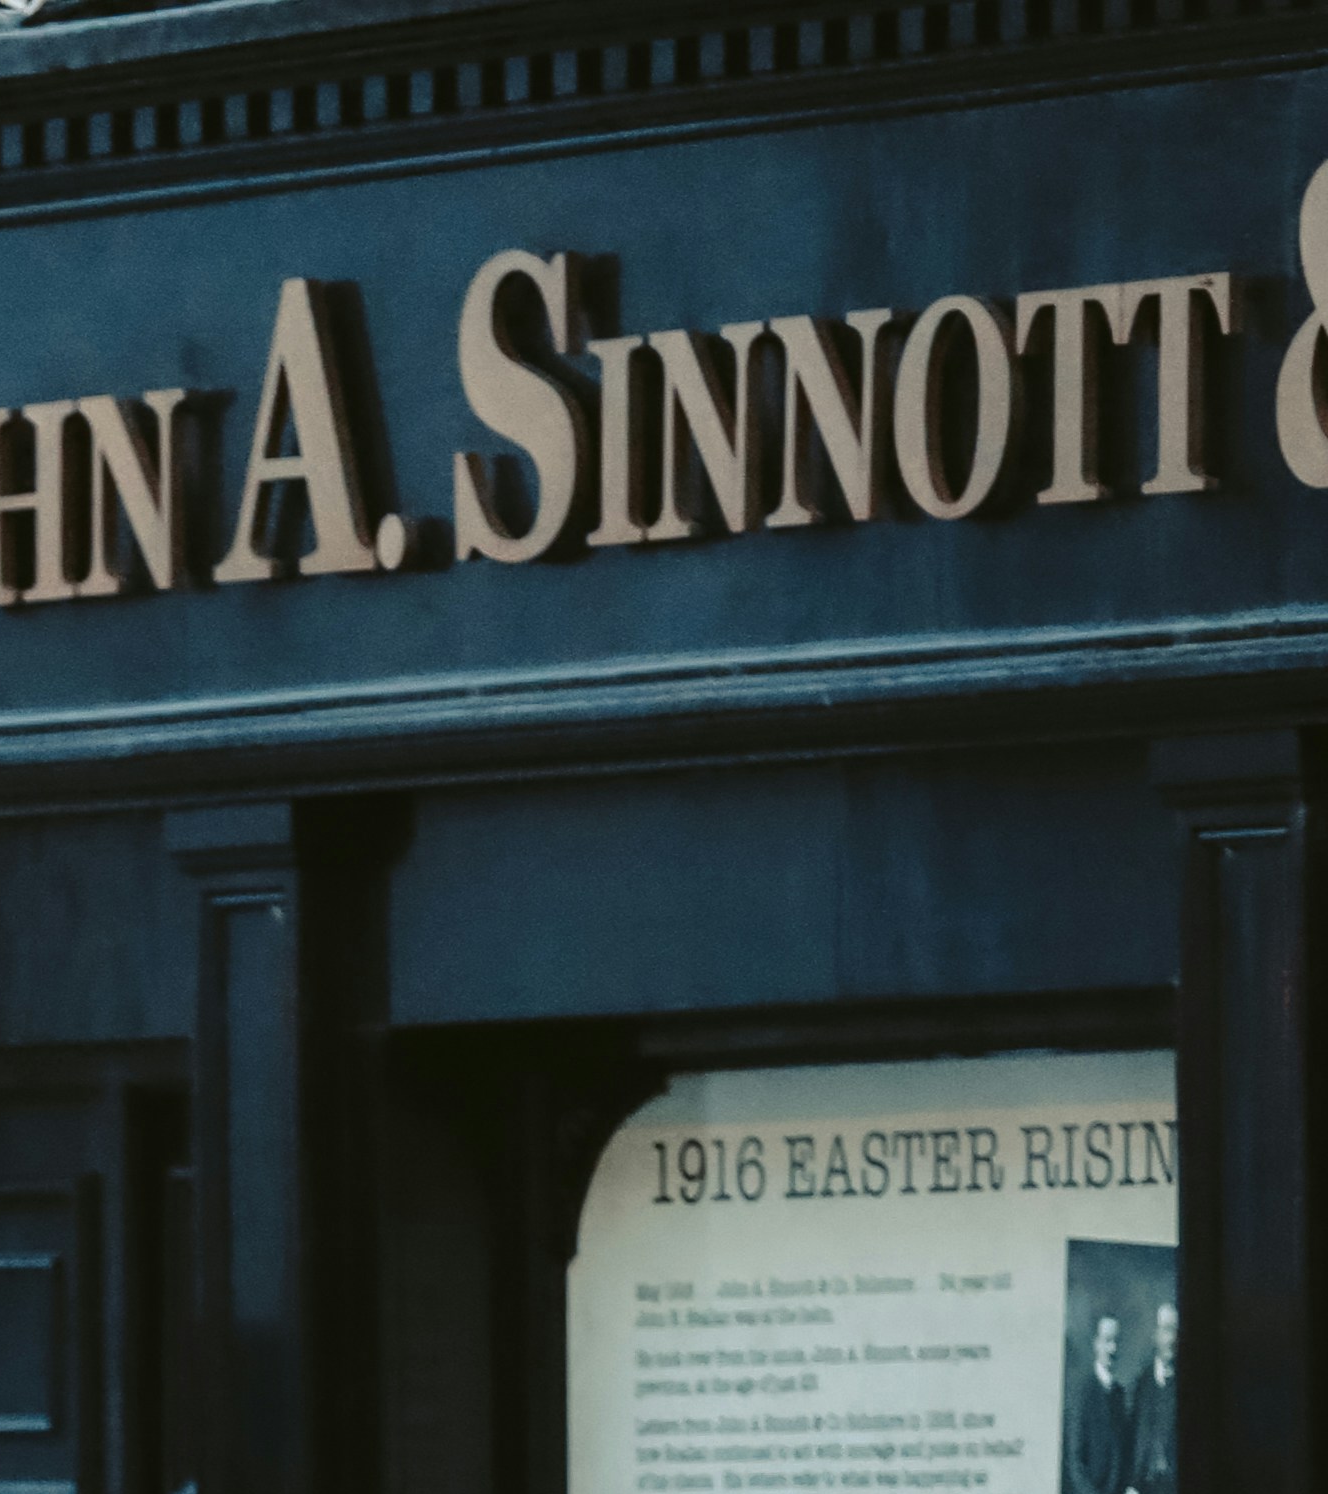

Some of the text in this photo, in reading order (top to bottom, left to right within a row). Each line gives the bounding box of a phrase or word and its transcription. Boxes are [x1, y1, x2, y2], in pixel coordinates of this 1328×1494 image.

[213, 275, 409, 584] A.
[454, 249, 1233, 564] SINNOTT
[653, 1136, 766, 1205] 1916
[784, 1125, 1004, 1200] EASTER
